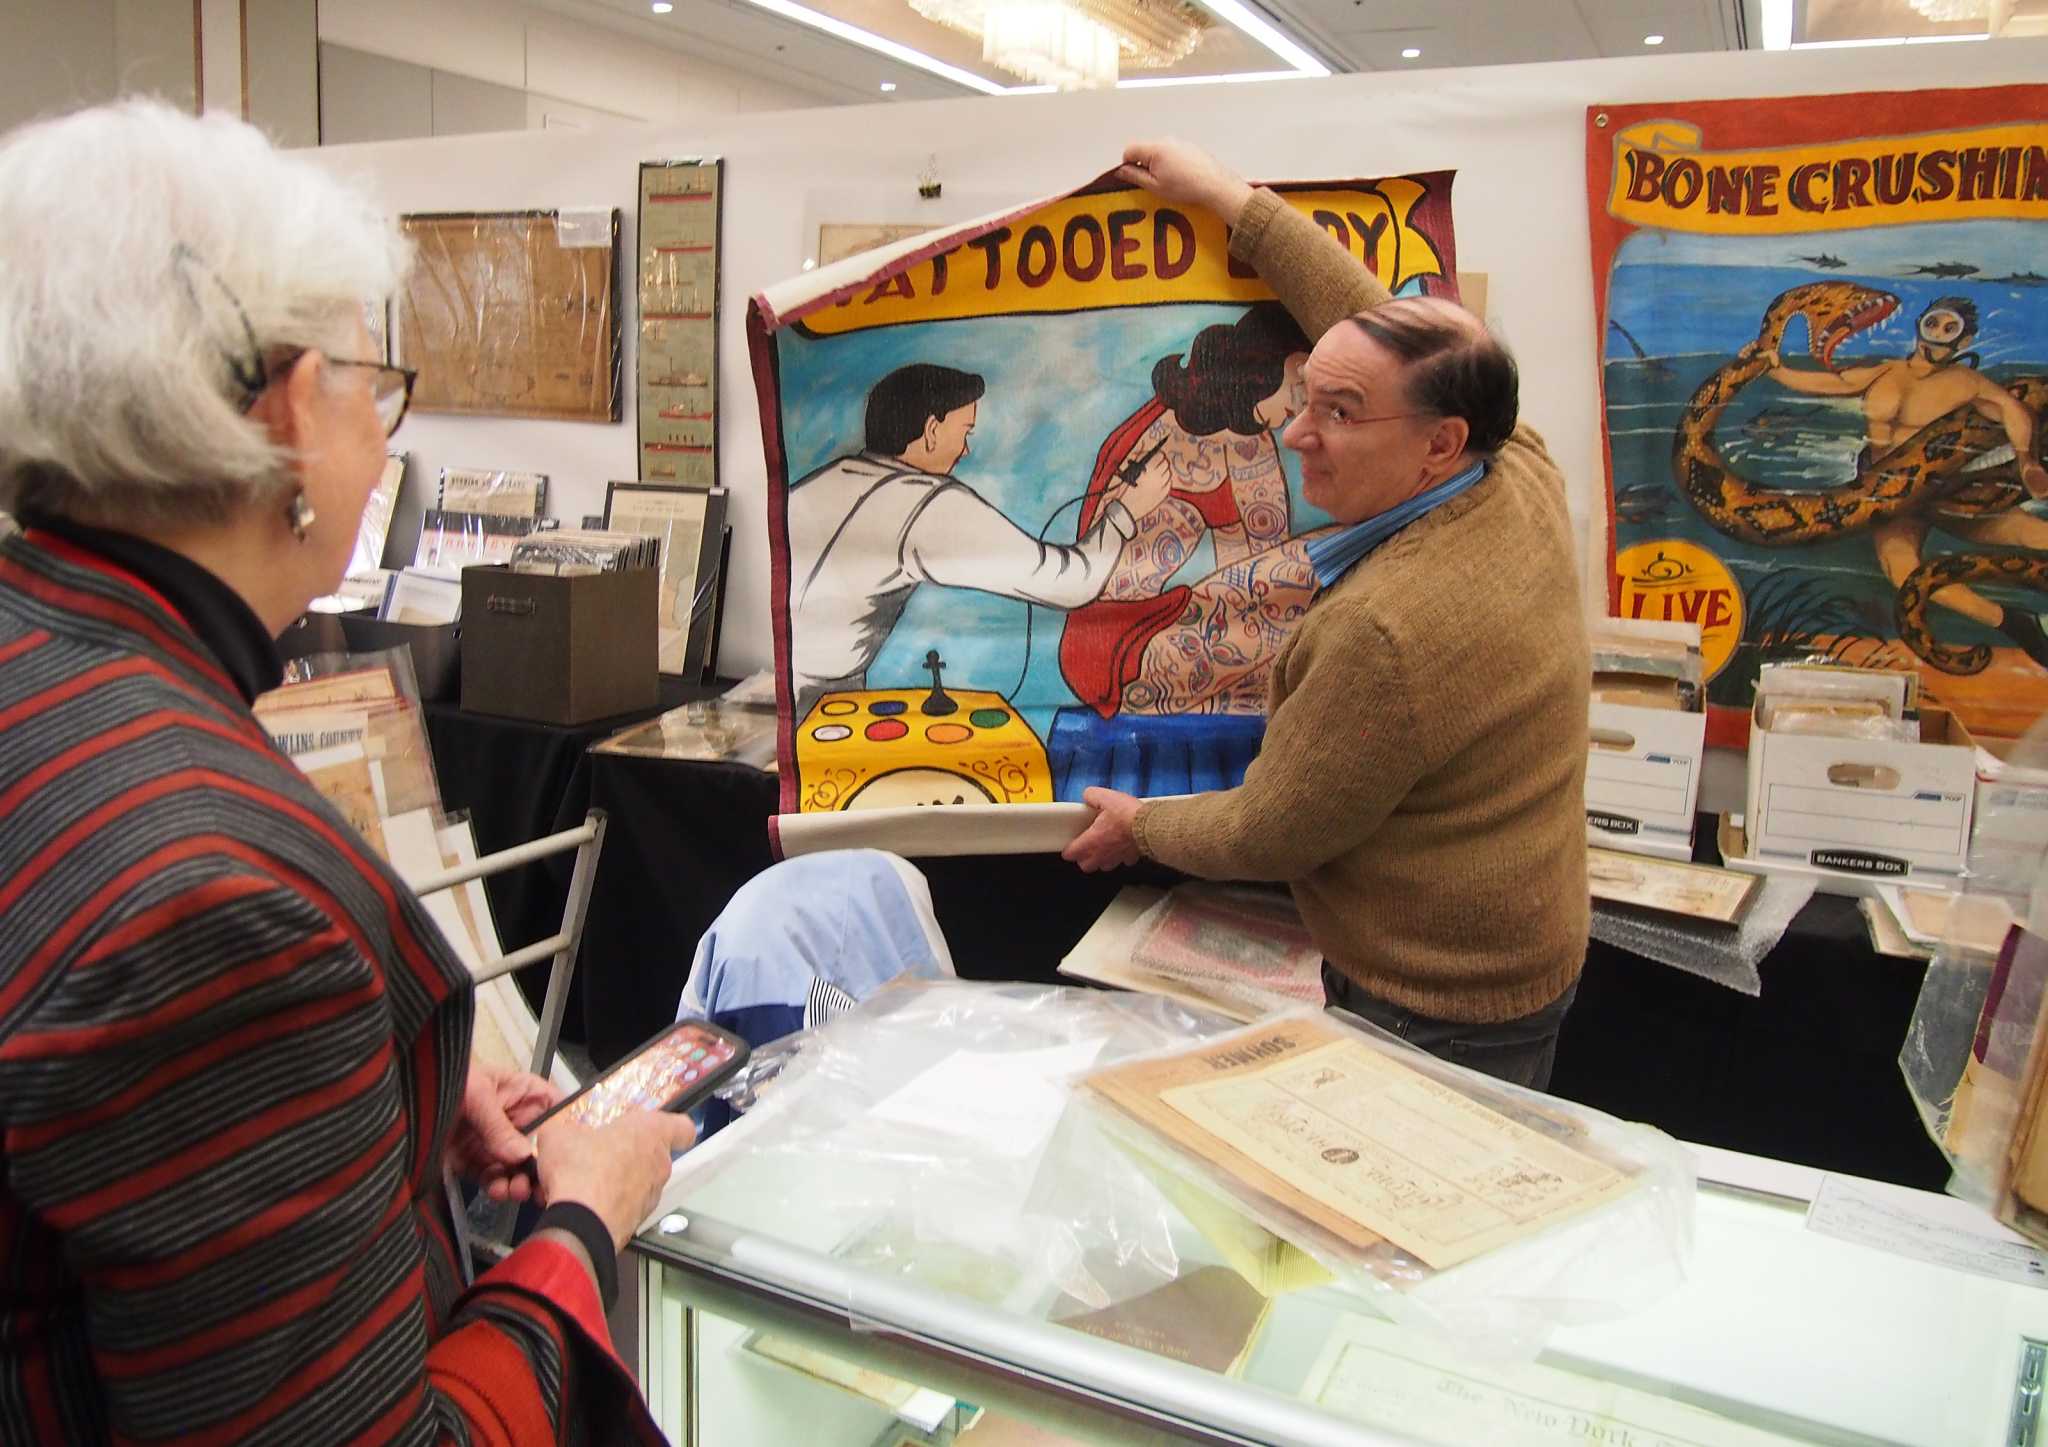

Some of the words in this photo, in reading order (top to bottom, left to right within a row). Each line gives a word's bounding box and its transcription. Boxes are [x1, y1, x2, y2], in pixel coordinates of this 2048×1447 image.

[1625, 149, 1781, 216] BONE
[835, 208, 1196, 307] ATTOOED
[1816, 854, 1873, 869] BANKERS
[1875, 861, 1902, 872] BOX
